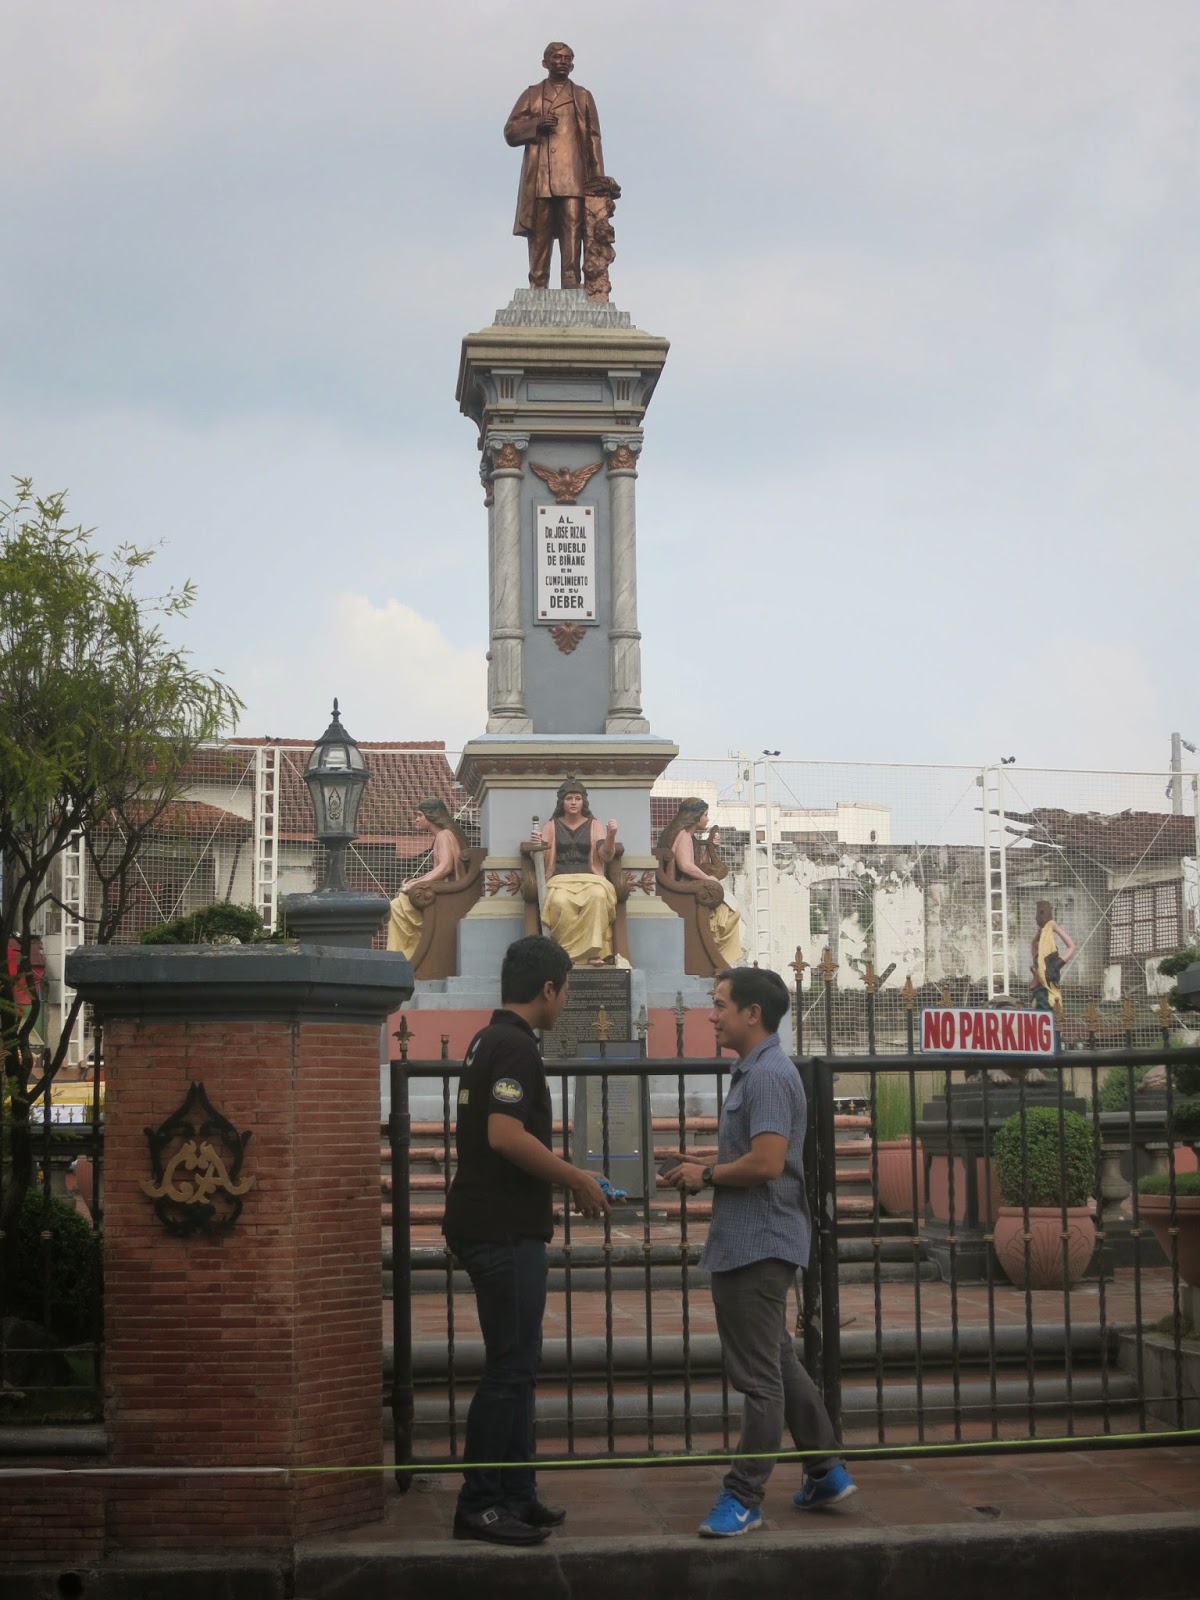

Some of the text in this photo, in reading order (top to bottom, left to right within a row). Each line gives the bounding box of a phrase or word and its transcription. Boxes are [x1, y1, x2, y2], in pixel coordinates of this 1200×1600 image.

[558, 515, 574, 524] AL
[570, 526, 587, 539] RIZAL
[546, 542, 586, 553] EL PUEBLO
[547, 555, 557, 566] DE
[545, 576, 588, 586] CUMPLIMIENTO
[550, 595, 584, 608] DEBER
[924, 1011, 1051, 1051] NO PARKING
